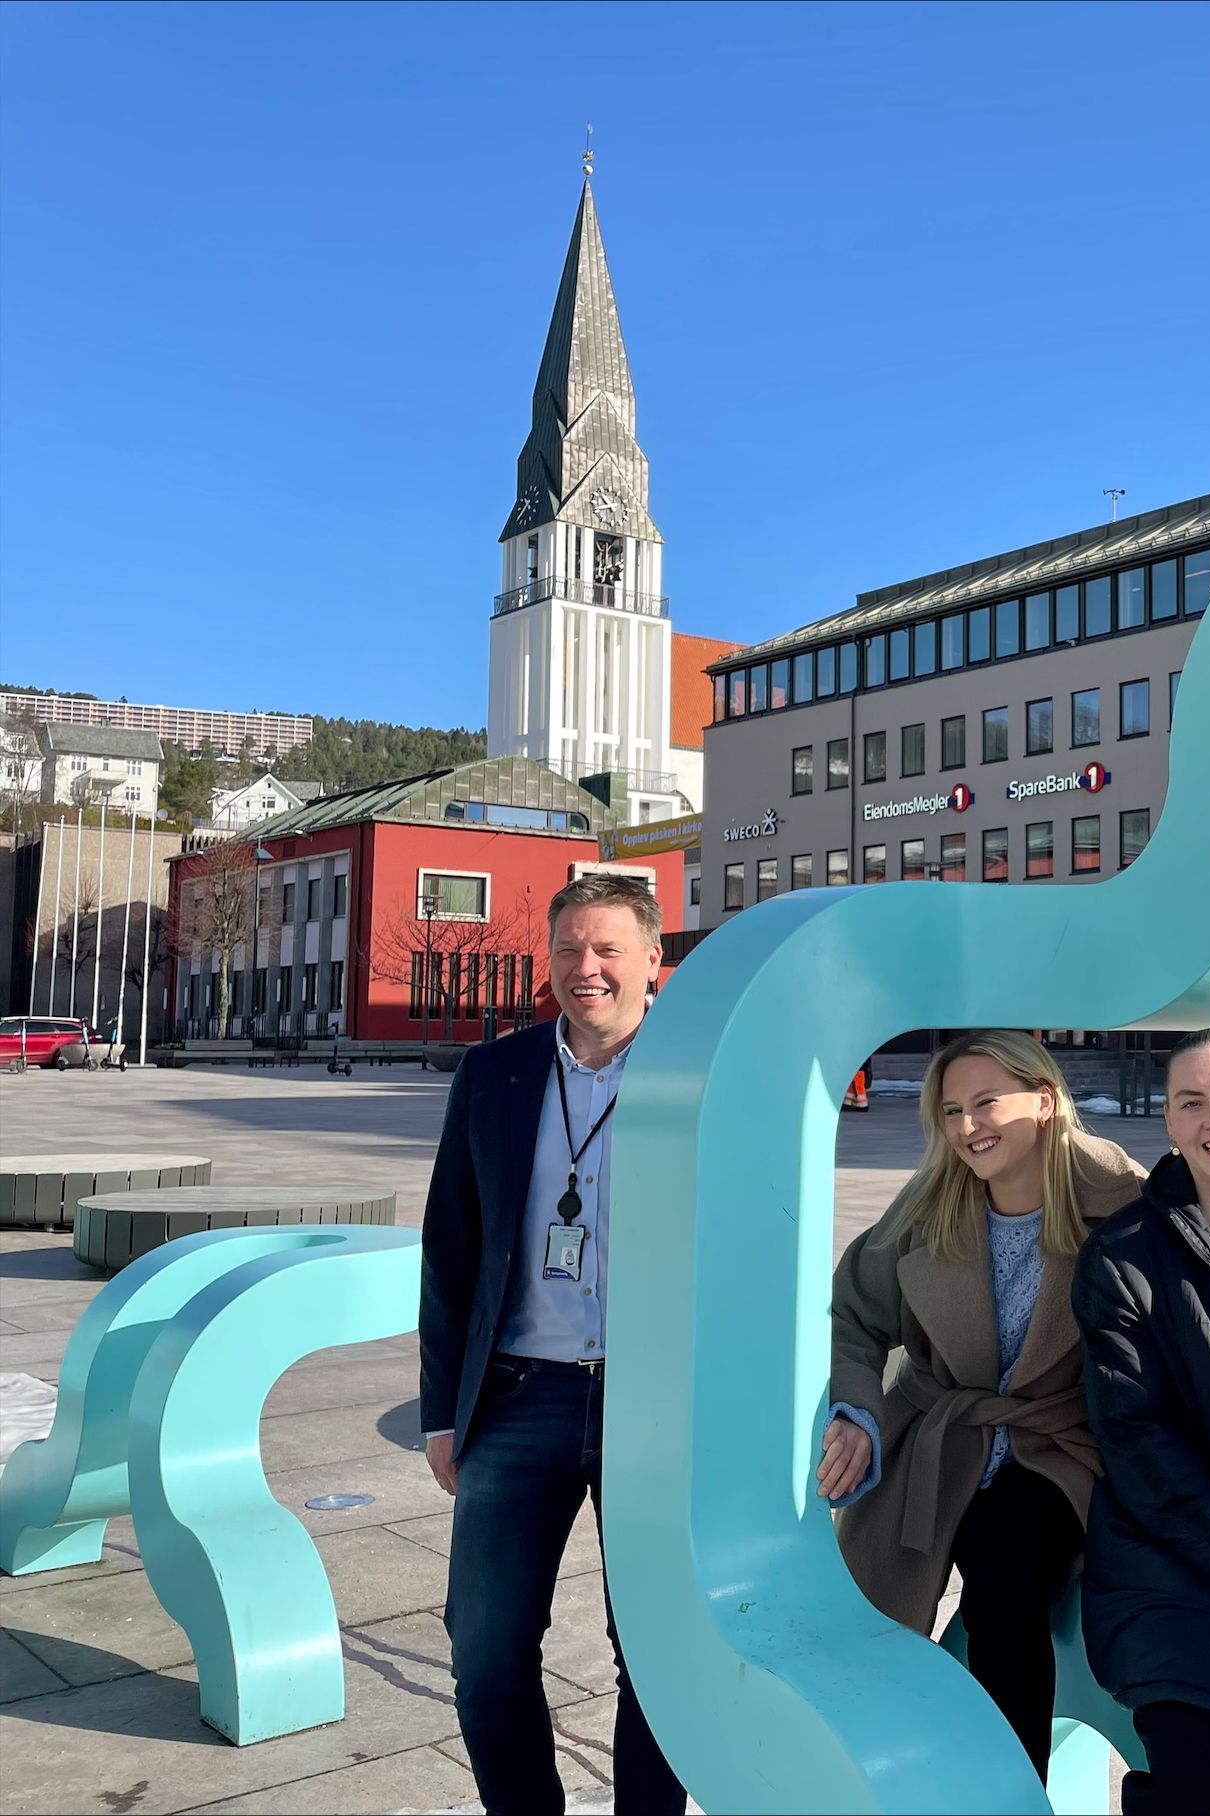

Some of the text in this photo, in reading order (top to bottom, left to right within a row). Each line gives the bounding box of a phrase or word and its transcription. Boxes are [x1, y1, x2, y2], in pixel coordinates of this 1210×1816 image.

[1009, 772, 1081, 801] SpareBank
[863, 793, 950, 820] EiendomsMegler
[623, 832, 650, 847] Opplev
[724, 824, 760, 842] SWECO
